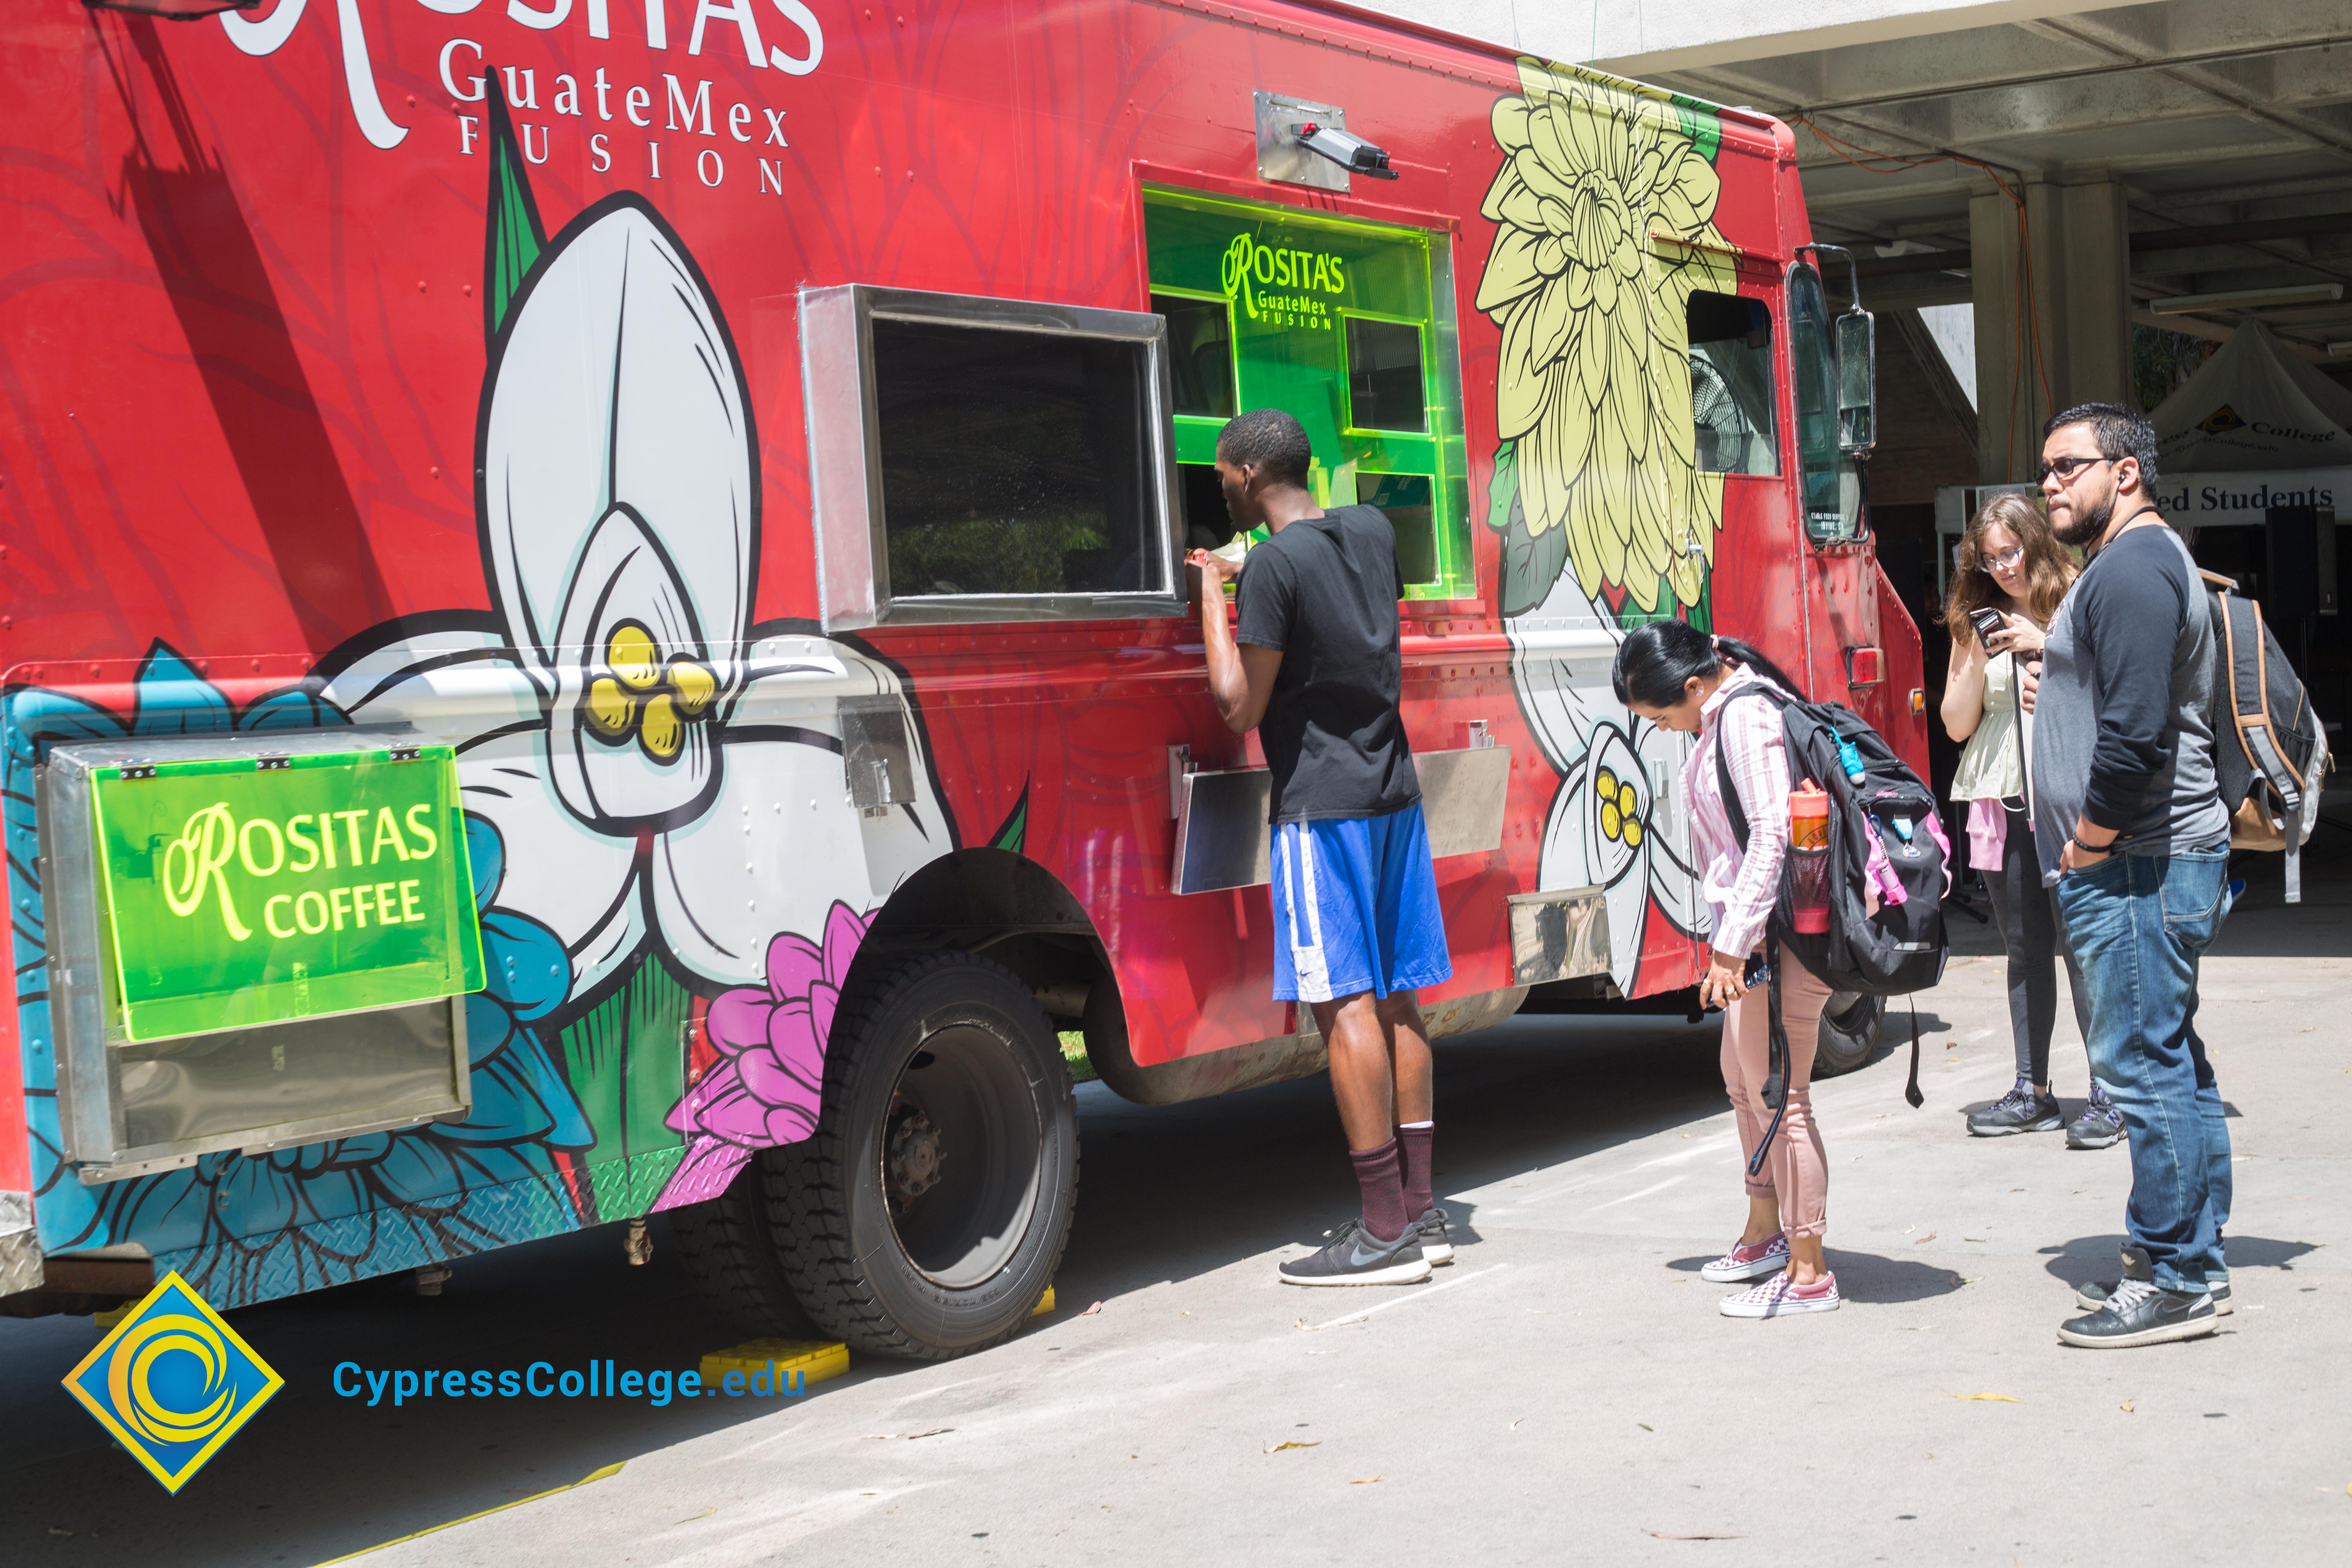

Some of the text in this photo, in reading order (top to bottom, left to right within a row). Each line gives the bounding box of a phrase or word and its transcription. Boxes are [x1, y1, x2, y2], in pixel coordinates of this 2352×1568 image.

[439, 38, 788, 148] GuateMex
[459, 116, 784, 196] FUSION
[1258, 290, 1326, 316] GuateMex
[1262, 313, 1331, 330] FUSION
[2251, 422, 2335, 443] College
[2201, 484, 2333, 511] Students
[163, 802, 438, 942] ROSITAS
[263, 879, 425, 938] COFFEE
